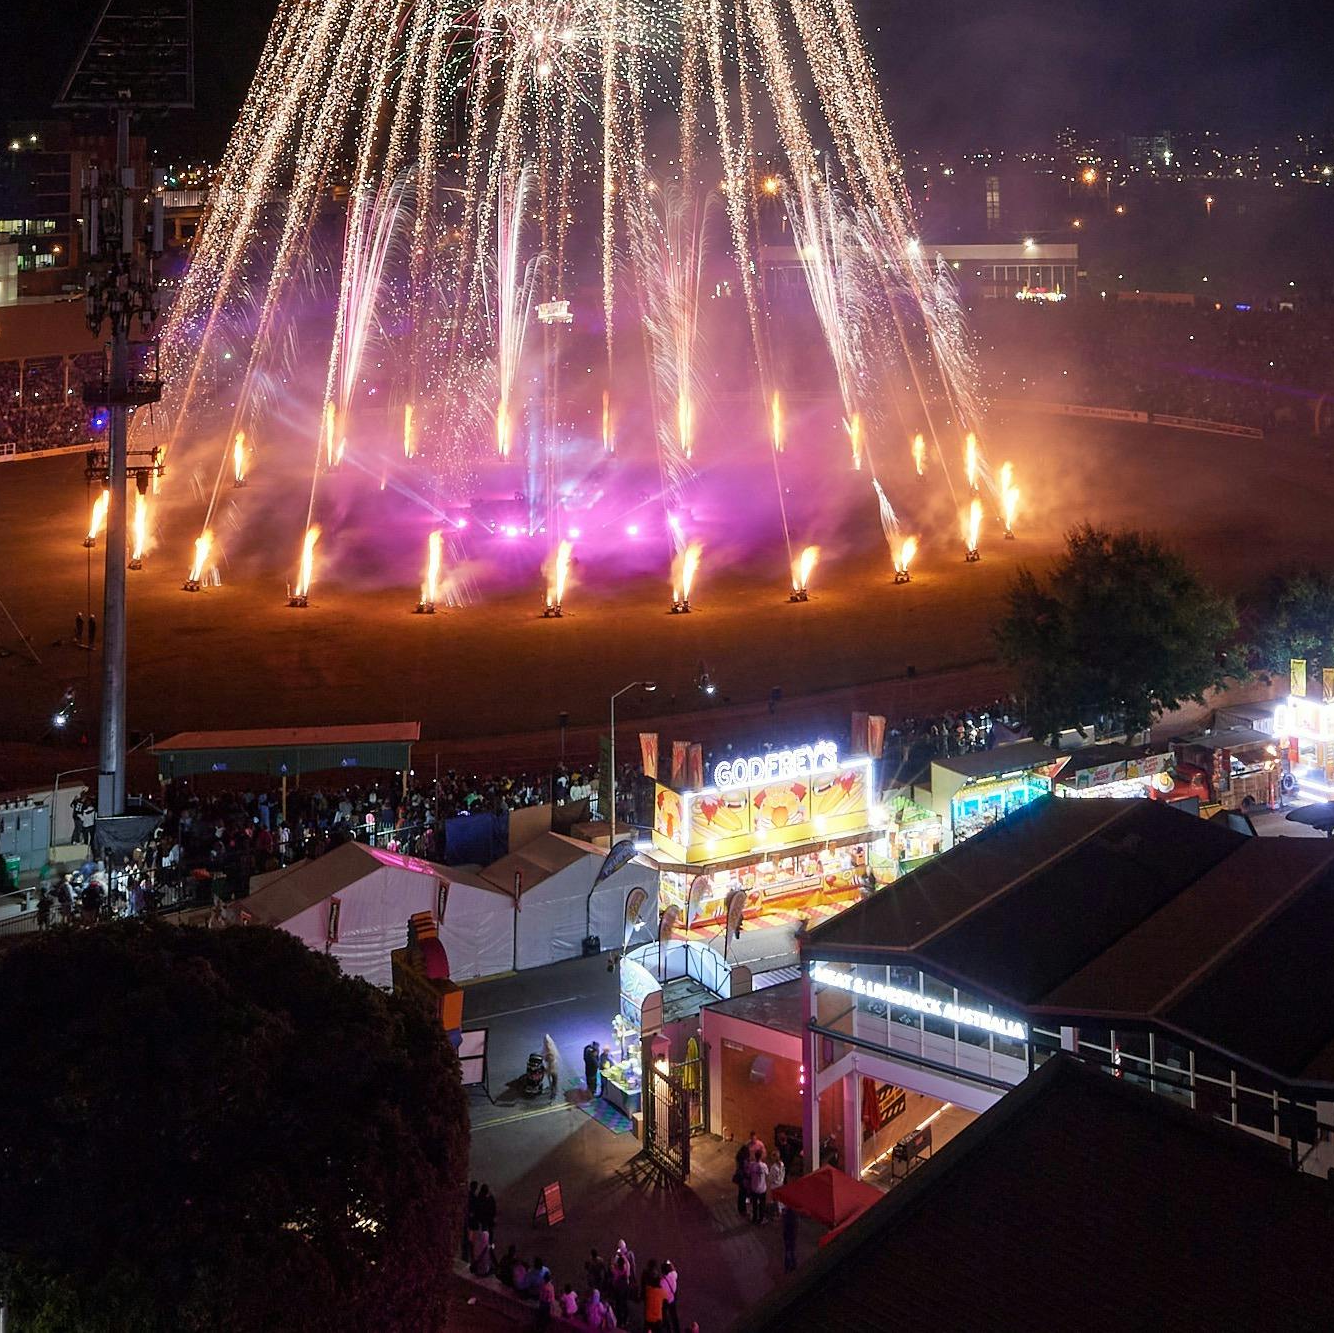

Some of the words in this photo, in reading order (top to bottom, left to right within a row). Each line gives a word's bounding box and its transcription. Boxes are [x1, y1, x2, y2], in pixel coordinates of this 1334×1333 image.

[714, 739, 838, 788] GODFREY'S
[866, 980, 944, 1017] LIVESTOCK
[942, 1003, 1027, 1040] AUSTRALIA
